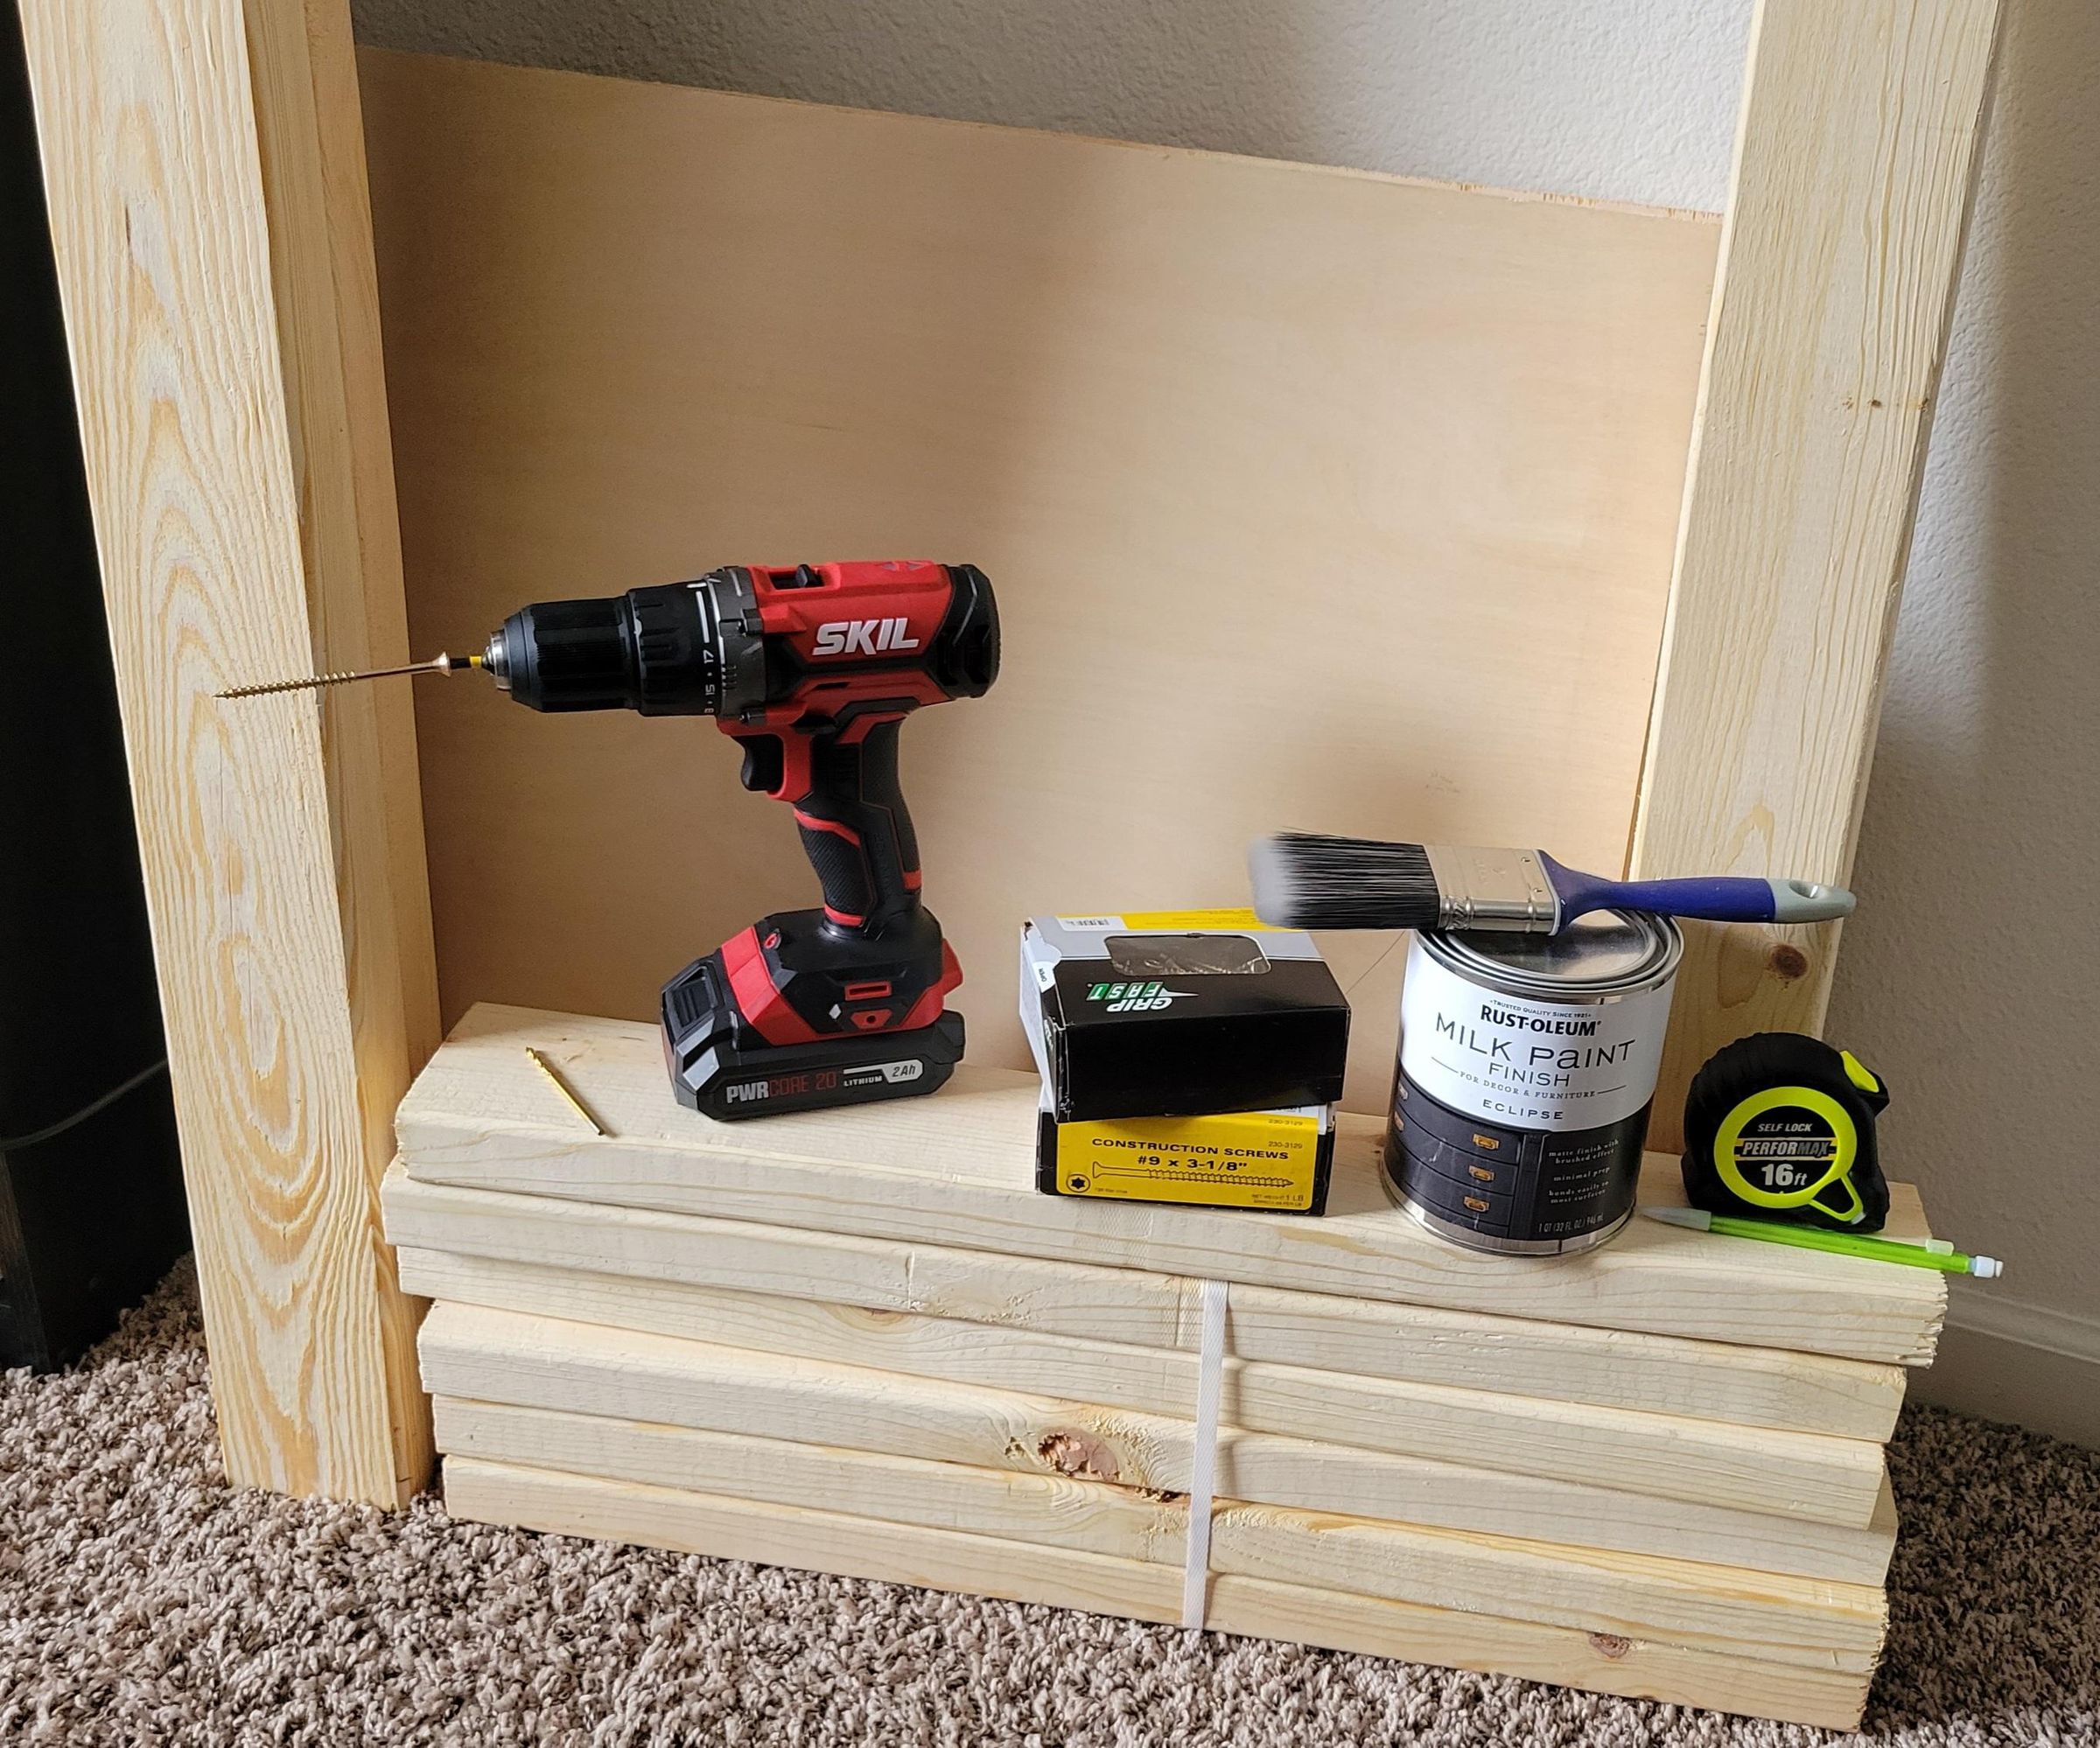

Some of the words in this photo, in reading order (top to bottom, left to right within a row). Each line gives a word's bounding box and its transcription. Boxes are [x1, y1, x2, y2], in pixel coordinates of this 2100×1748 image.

[812, 618, 920, 655] SKIL
[703, 649, 715, 664] 17
[704, 683, 716, 696] 15
[1087, 982, 1162, 1000] FAST
[1106, 997, 1172, 1012] GRIP
[1493, 1000, 1522, 1011] TRUSTED
[1522, 1007, 1550, 1017] QUALITY
[1436, 1012, 1512, 1062] MILK
[892, 1063, 916, 1078] 2Ah
[1488, 1062, 1570, 1087] FINISH
[816, 1071, 837, 1091] 20
[843, 1075, 883, 1087] LITHIUM
[1460, 1072, 1479, 1084] FOR
[1483, 1080, 1519, 1094] DECOR
[1535, 1091, 1595, 1100] FURNITURE
[1482, 1099, 1564, 1120] ECLIPSE
[1757, 1123, 1783, 1132] SELF
[1785, 1123, 1813, 1132] LOCK
[1092, 1138, 1219, 1155] CONSTRUCTION
[1223, 1148, 1289, 1160] SCREWS
[1577, 1144, 1602, 1156] finish
[1604, 1138, 1619, 1149] with
[1742, 1142, 1829, 1157] PERFORMAX
[1138, 1155, 1160, 1165] #9
[1168, 1159, 1180, 1168] x
[1555, 1154, 1591, 1164] brushed
[1592, 1148, 1614, 1160] effect
[1553, 1171, 1591, 1182] minimal
[1592, 1166, 1611, 1178] prep
[1574, 1189, 1606, 1201] surfaces
[1577, 1183, 1600, 1193] easily
